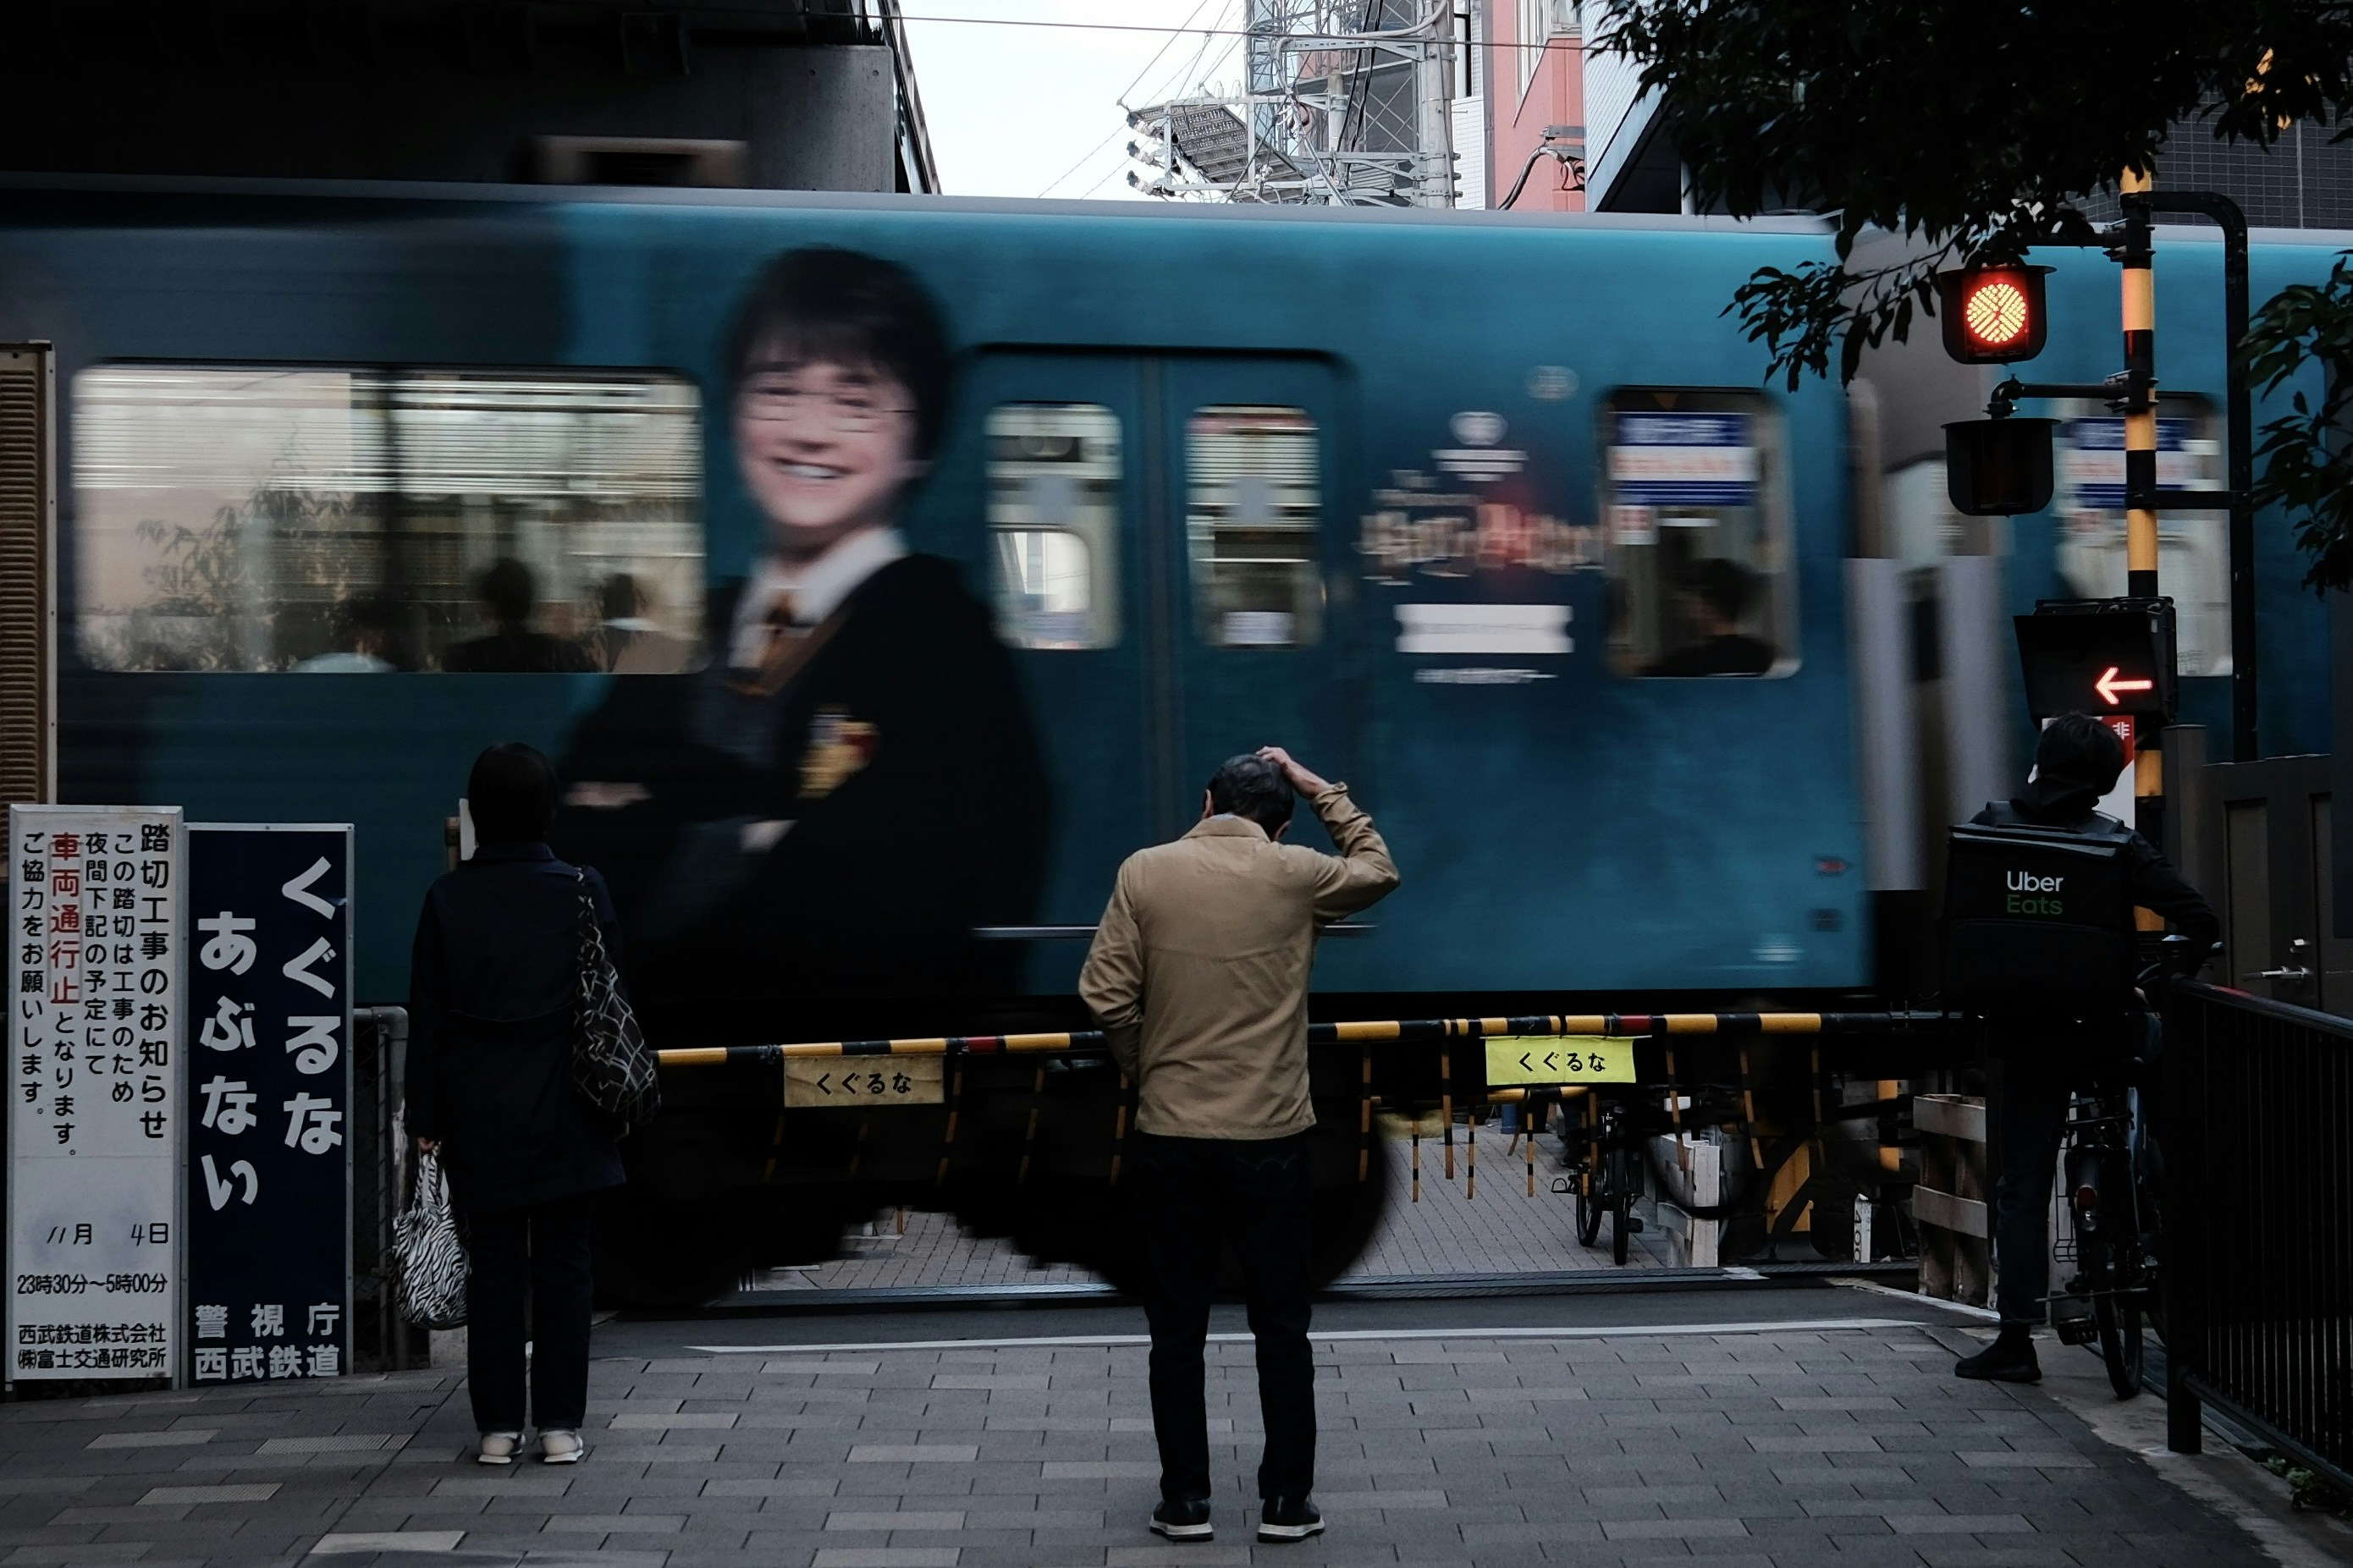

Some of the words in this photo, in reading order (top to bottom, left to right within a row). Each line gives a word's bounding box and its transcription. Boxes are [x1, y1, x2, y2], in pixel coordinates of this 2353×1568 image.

[2007, 870, 2064, 892] Uber
[2007, 894, 2064, 915] Eats
[20, 832, 44, 1114] ご協力をお願いします。
[50, 832, 80, 1156] 車両通行止となります。
[85, 832, 108, 1075] 夜間下記の予定にて
[112, 834, 135, 1103] この踏切は工事のため
[139, 823, 169, 1139] 踏切工事のお知らせ
[282, 856, 343, 1155] くぐるな
[197, 911, 258, 1211] あぶない
[817, 1072, 912, 1096] くぐるな
[1518, 1051, 1606, 1073] くぐるな
[18, 1323, 167, 1345] 西武鉄道株式会社
[194, 1343, 340, 1381] 西武鉄道
[195, 1301, 340, 1339] 警視庁
